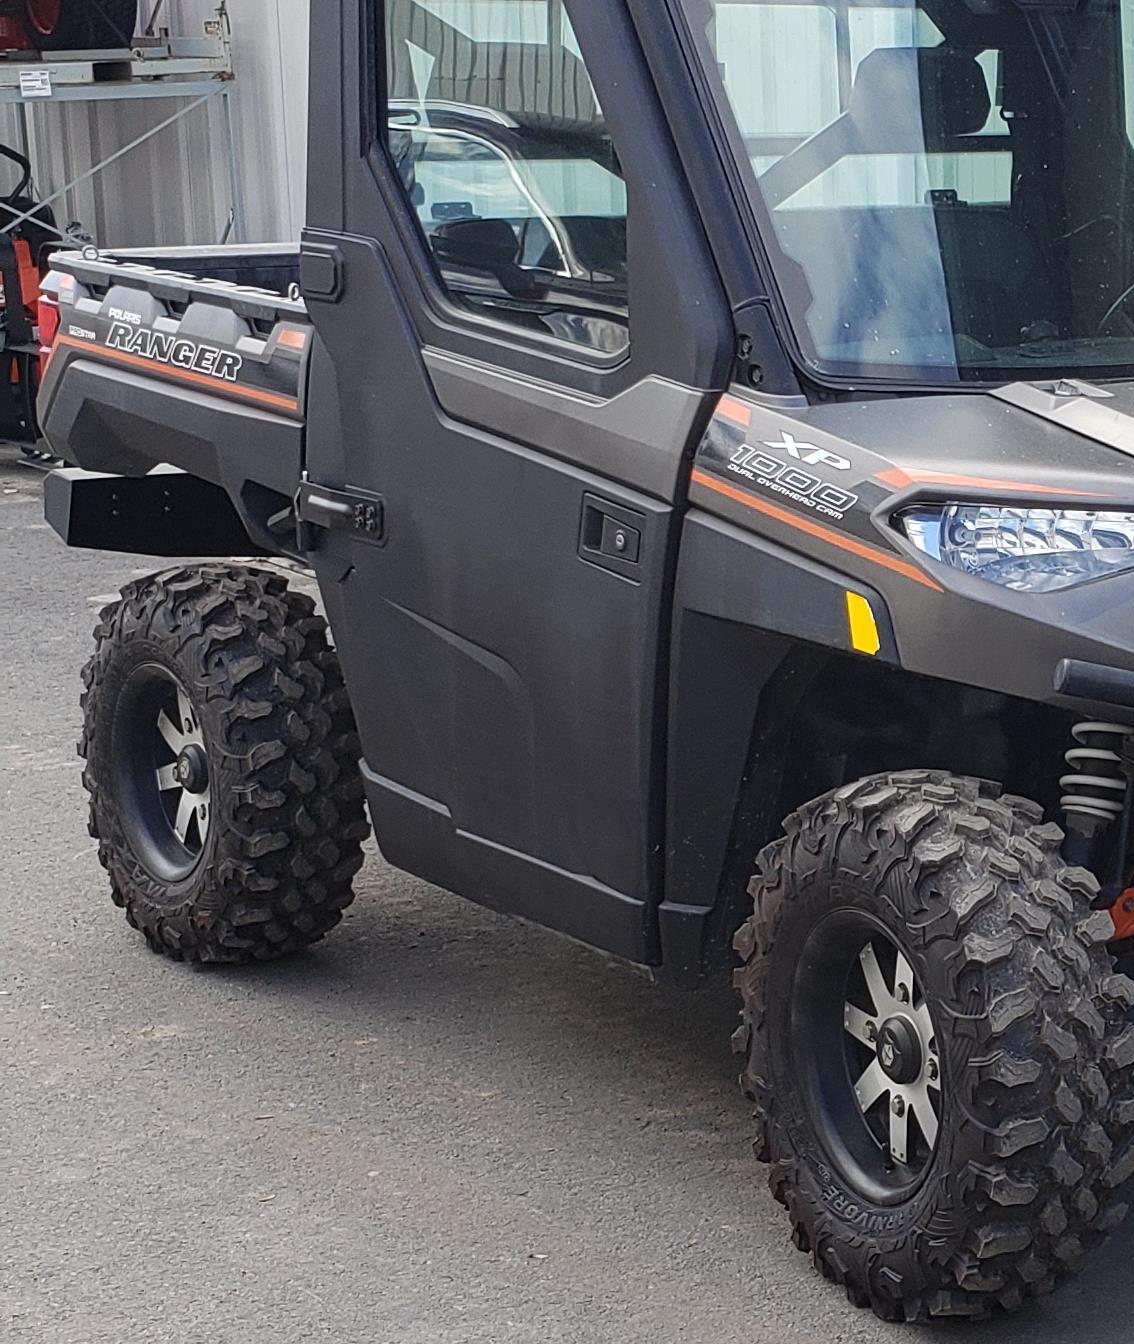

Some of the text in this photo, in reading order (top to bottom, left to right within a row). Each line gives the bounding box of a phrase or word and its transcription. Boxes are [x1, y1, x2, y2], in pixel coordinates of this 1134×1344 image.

[108, 307, 142, 324] POLARIS
[105, 321, 242, 382] RANGER
[729, 443, 859, 512] 1000
[762, 430, 851, 470] XP
[727, 463, 844, 520] DUAL OVERHEAD CAM
